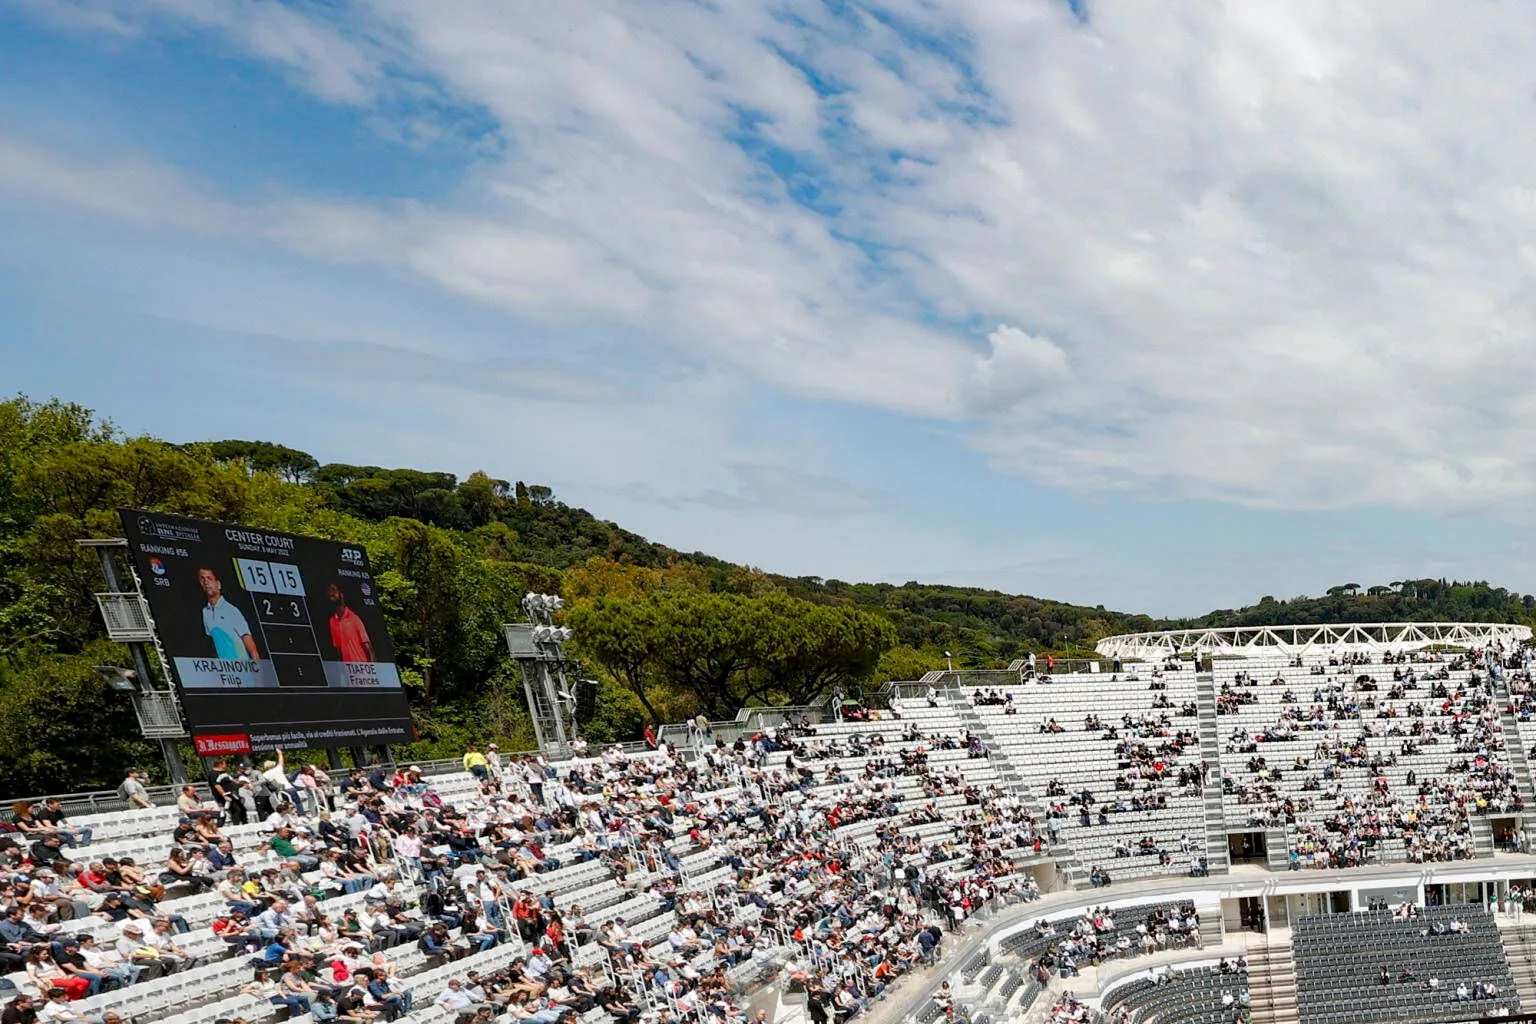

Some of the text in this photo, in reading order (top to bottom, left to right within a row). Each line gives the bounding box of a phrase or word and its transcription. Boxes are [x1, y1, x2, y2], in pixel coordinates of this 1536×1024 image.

[225, 529, 295, 550] CENTER COURT
[341, 547, 363, 561] ATP
[153, 577, 170, 588] SRB
[247, 566, 298, 589] 15 15
[262, 599, 301, 618] 2 3
[193, 660, 260, 674] KRAJINOVIC
[344, 663, 377, 675] TIAFOE
[220, 674, 243, 689] Filip
[349, 674, 381, 686] Frances
